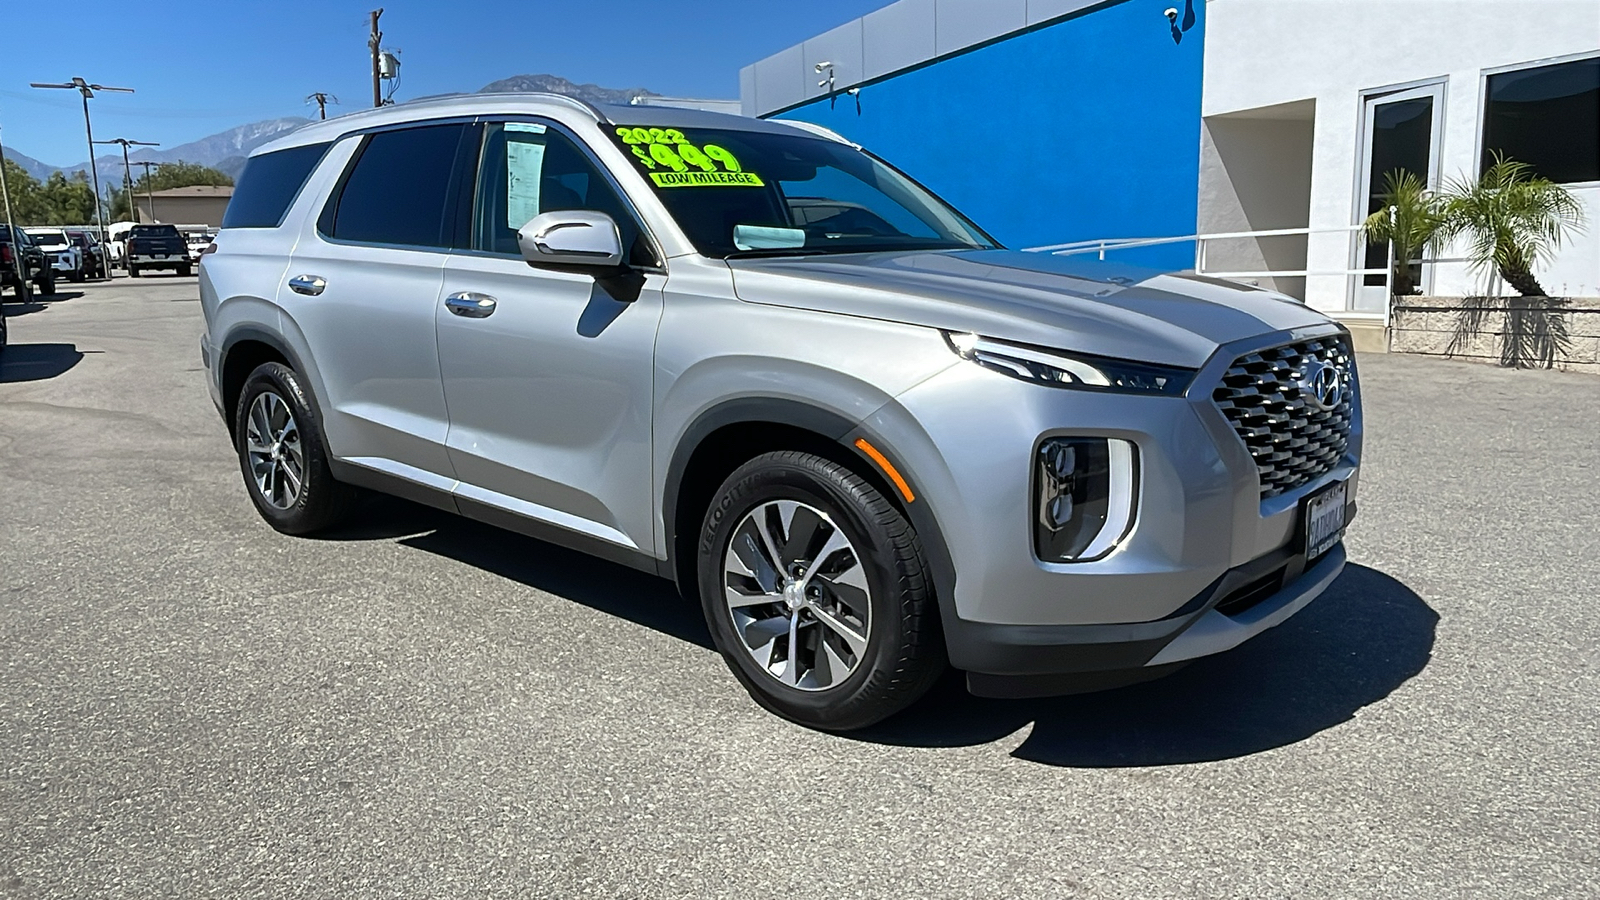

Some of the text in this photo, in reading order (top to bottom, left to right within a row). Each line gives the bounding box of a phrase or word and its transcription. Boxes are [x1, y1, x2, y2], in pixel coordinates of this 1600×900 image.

[616, 127, 690, 144] 2022
[659, 173, 754, 185] LOW MILEAGE
